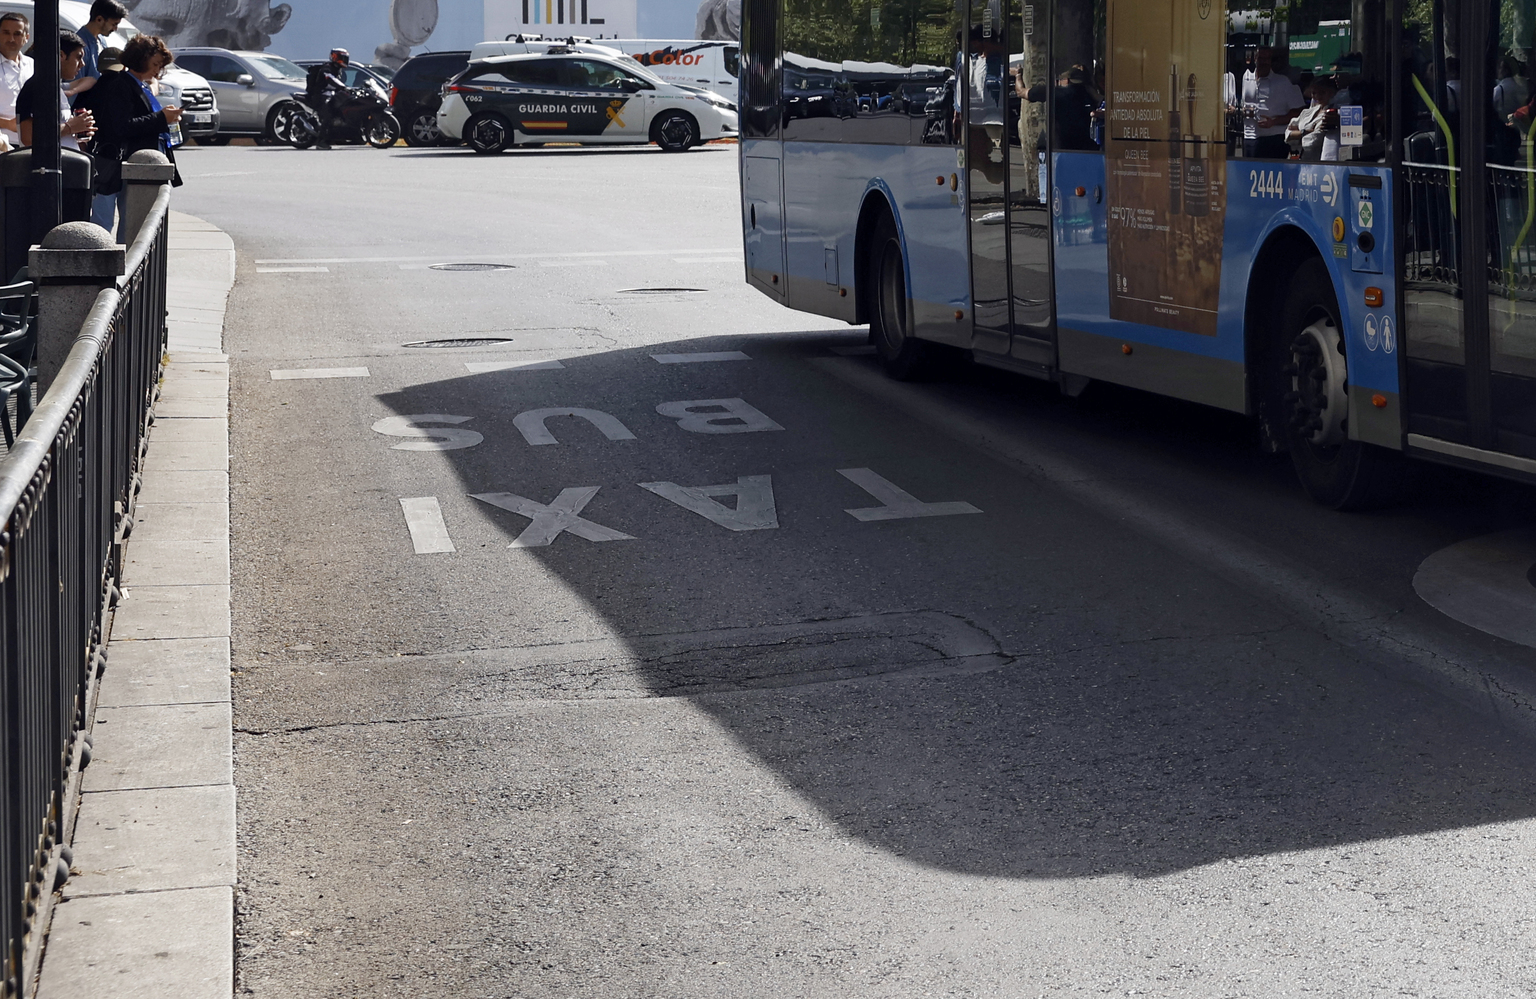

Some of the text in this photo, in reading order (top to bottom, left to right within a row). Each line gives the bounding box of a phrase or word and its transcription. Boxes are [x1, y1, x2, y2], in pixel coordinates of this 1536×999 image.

[649, 49, 704, 66] Color
[1113, 89, 1160, 103] TRANSFORMACIÓN
[518, 103, 598, 114] GUARDIA CIVIL
[1110, 108, 1163, 121] ANTIEDAD ABSOLUTA
[1123, 127, 1151, 139] DE LA PIEL
[1124, 149, 1149, 161] QUEEN BEE
[1250, 169, 1284, 199] 2444
[1301, 173, 1318, 186] EMT
[1288, 187, 1319, 202] MADRID
[1120, 207, 1137, 228] 97%
[371, 397, 786, 452] BUS
[399, 467, 984, 554] TAXI
